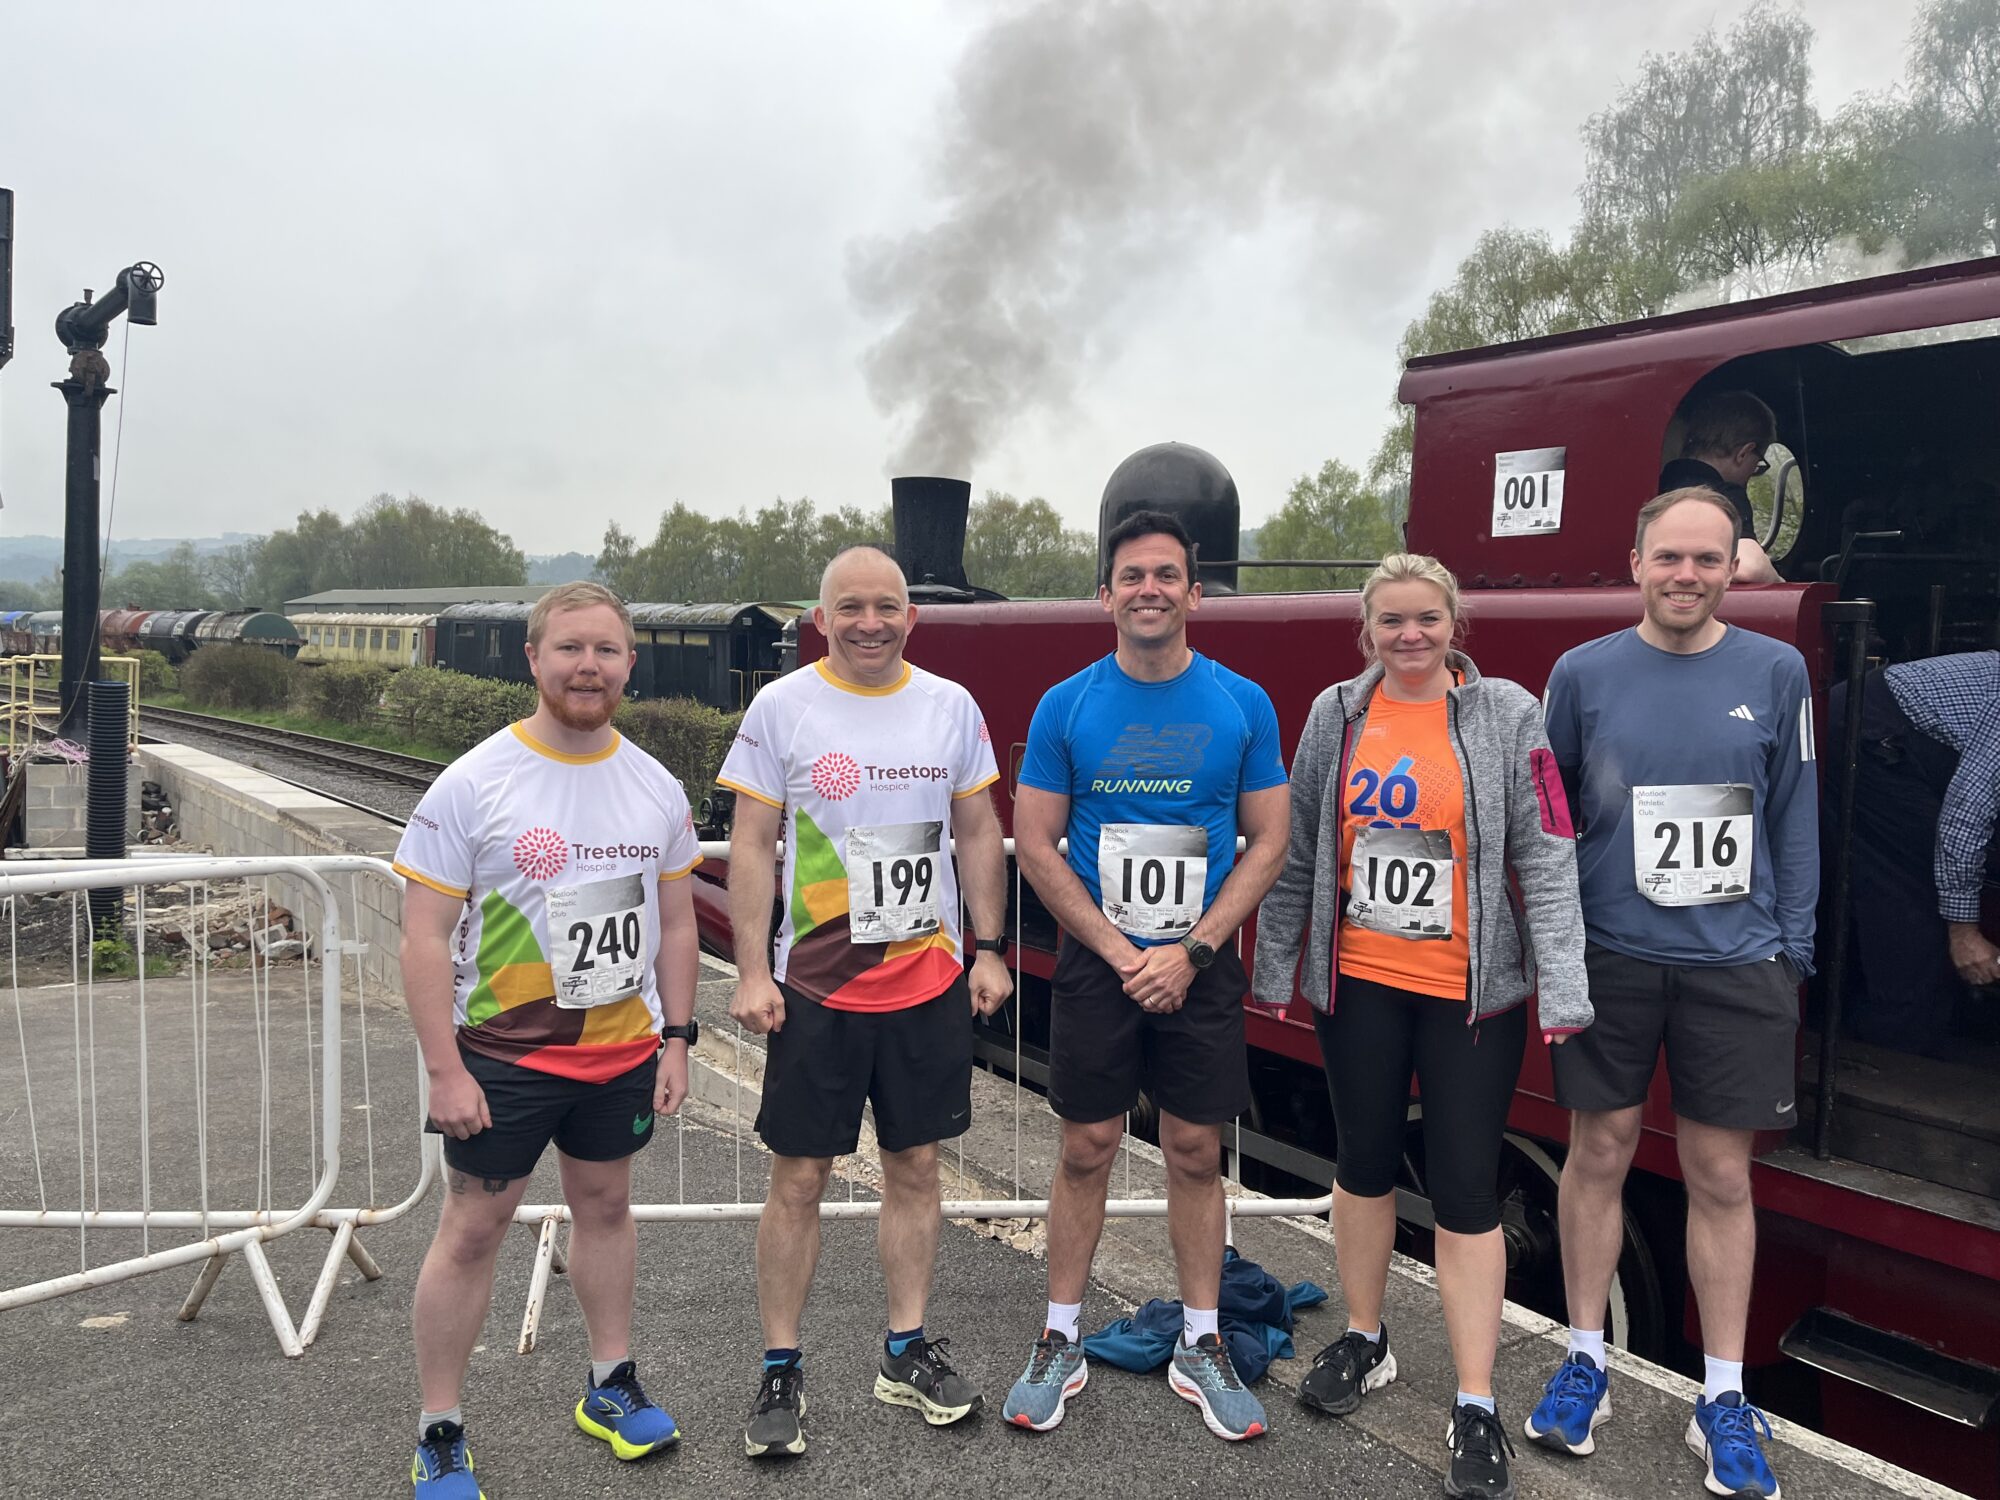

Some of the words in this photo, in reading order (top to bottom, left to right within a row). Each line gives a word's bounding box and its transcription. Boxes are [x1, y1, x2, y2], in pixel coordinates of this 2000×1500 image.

[1504, 474, 1549, 510] 001
[864, 765, 948, 782] Treetops
[870, 783, 910, 792] Hospice
[1091, 780, 1193, 793] RUNNING
[571, 843, 659, 862] Treetops
[1654, 820, 1737, 869] 216
[576, 862, 617, 872] Hospice
[872, 857, 932, 907] 199
[1122, 858, 1185, 905] 101
[1368, 857, 1436, 906] 102
[568, 911, 640, 972] 240
